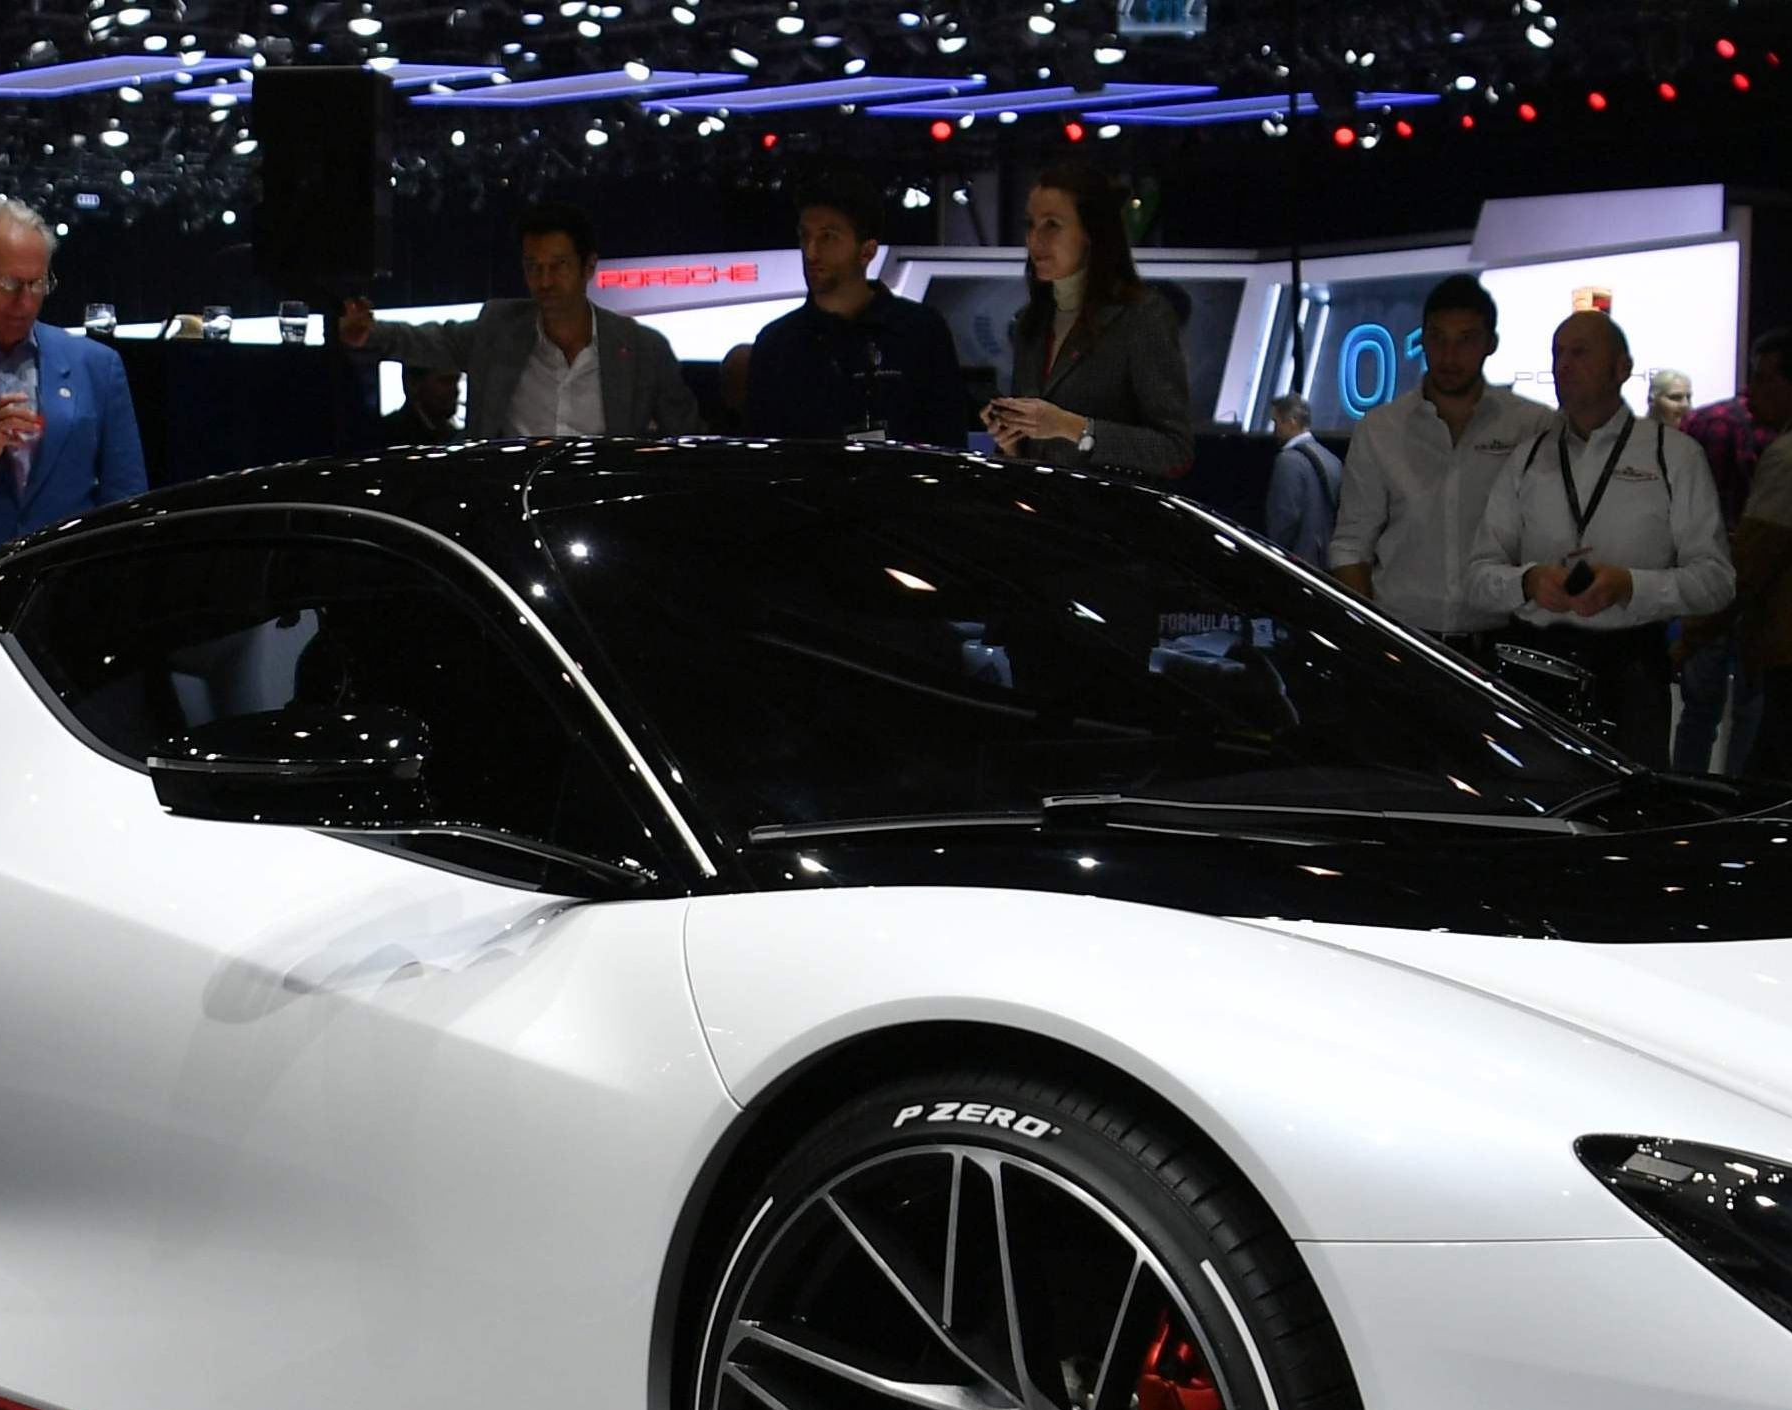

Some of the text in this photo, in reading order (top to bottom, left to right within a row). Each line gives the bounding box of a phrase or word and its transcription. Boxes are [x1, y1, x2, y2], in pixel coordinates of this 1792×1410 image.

[597, 264, 758, 290] PORSCHE
[892, 1101, 1052, 1139] P ZERO
